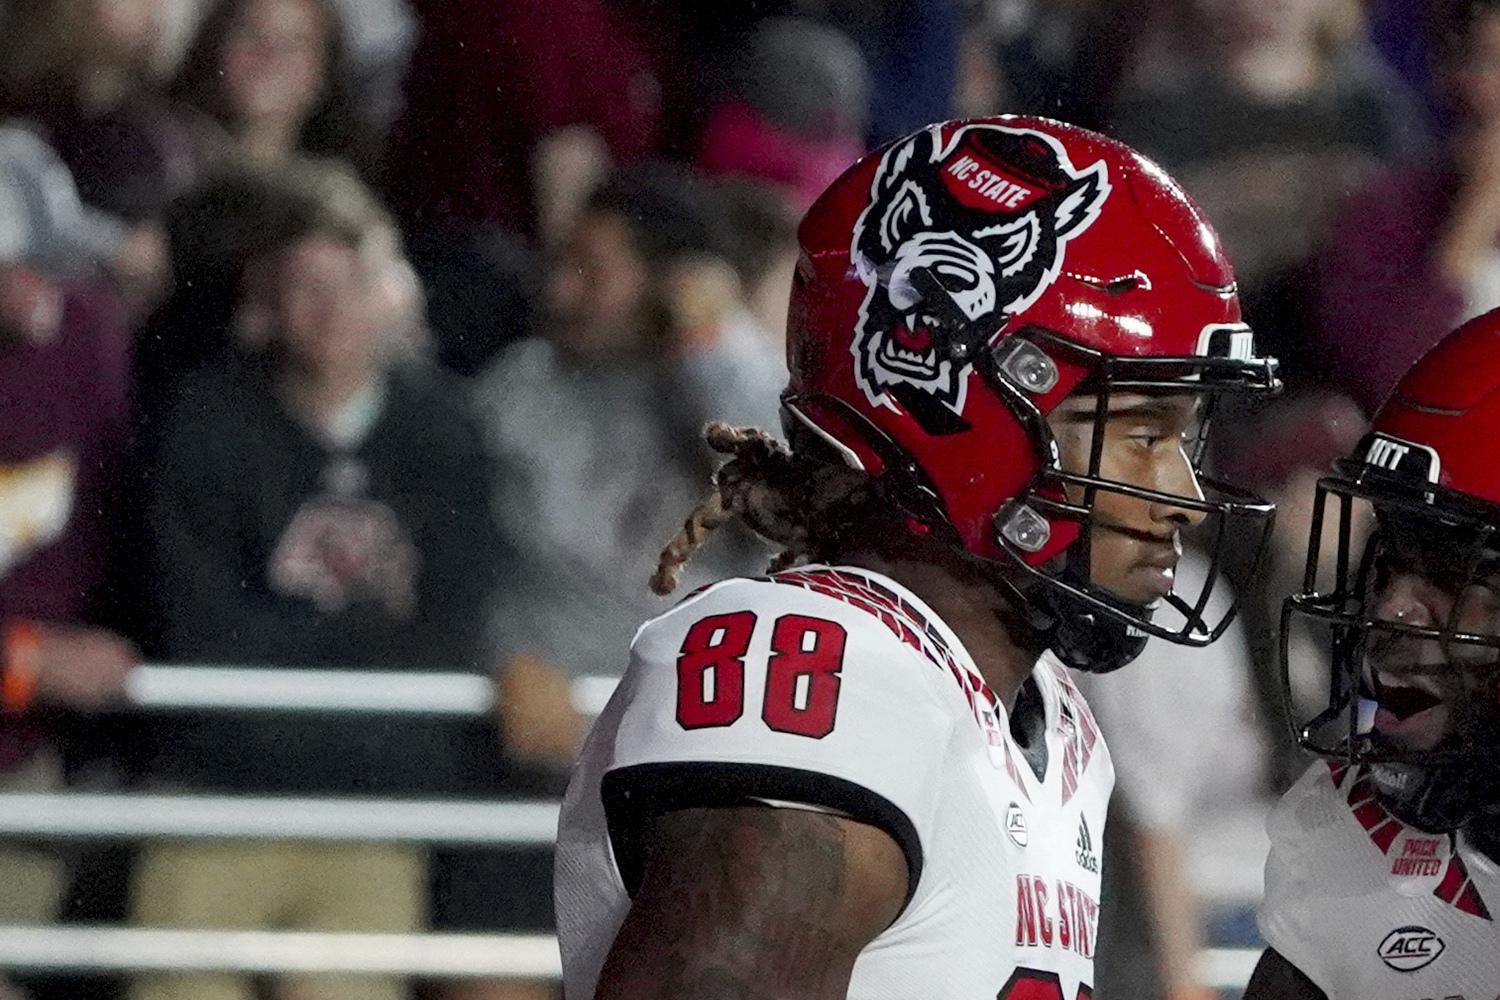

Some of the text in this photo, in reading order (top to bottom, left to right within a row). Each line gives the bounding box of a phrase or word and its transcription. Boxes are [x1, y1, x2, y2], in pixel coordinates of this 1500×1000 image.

[947, 155, 1032, 208] NC STATE
[675, 610, 848, 740] 88
[1402, 838, 1442, 858] PACK
[1391, 857, 1443, 877] UNITED
[1015, 873, 1054, 948] NC
[1385, 936, 1437, 955] ACC
